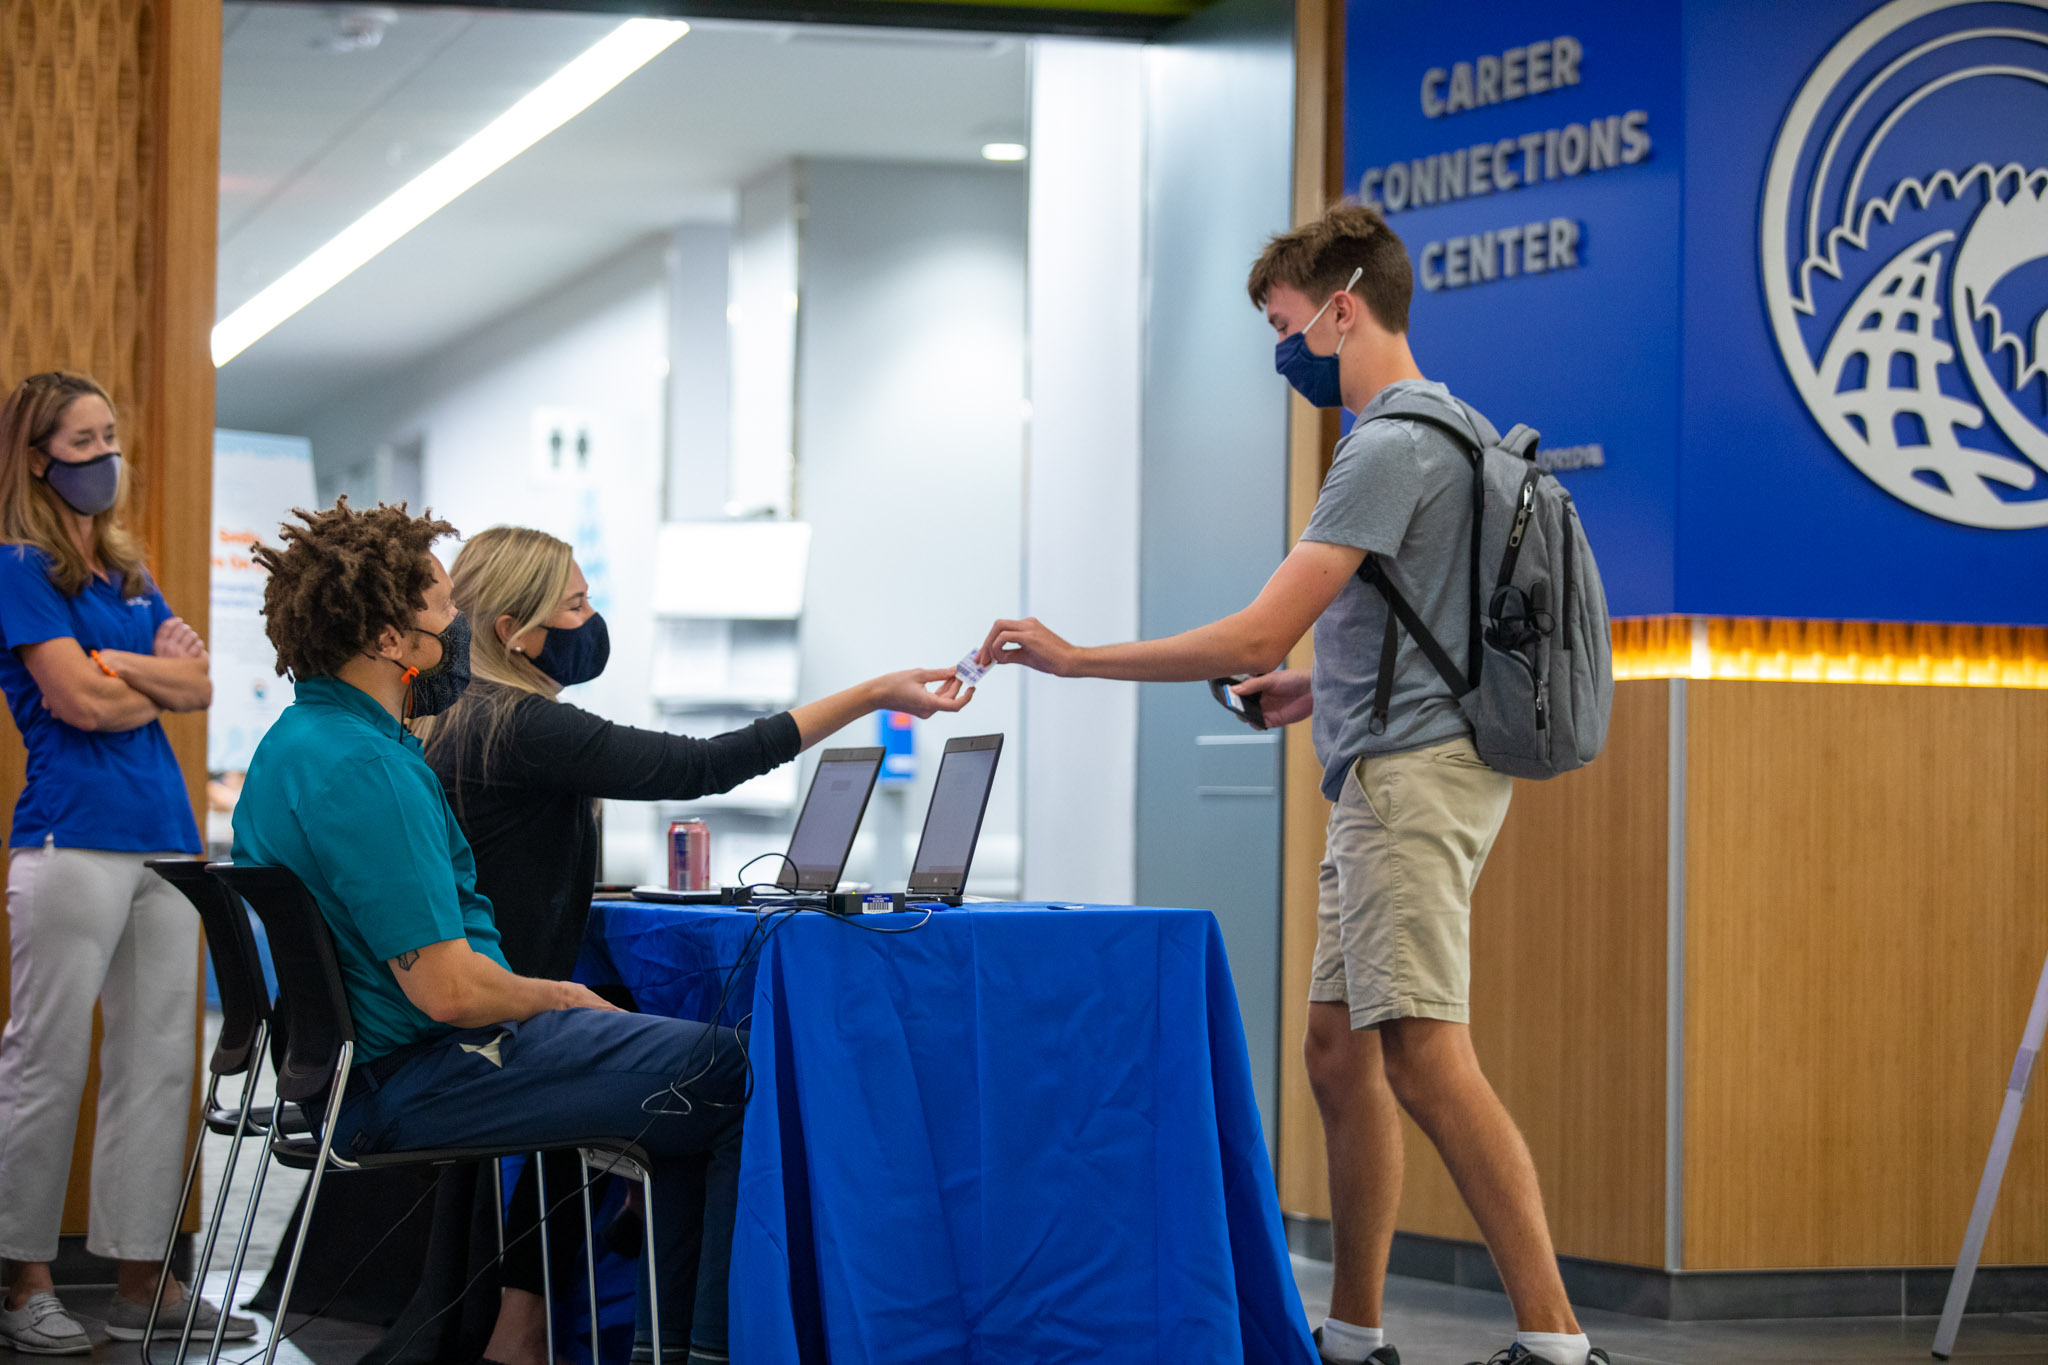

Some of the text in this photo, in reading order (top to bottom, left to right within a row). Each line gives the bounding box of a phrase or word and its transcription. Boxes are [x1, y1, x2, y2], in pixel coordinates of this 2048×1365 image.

[1421, 36, 1582, 118] CAREER
[1359, 110, 1650, 215] CONNECTIONS
[1420, 217, 1580, 290] CENTER
